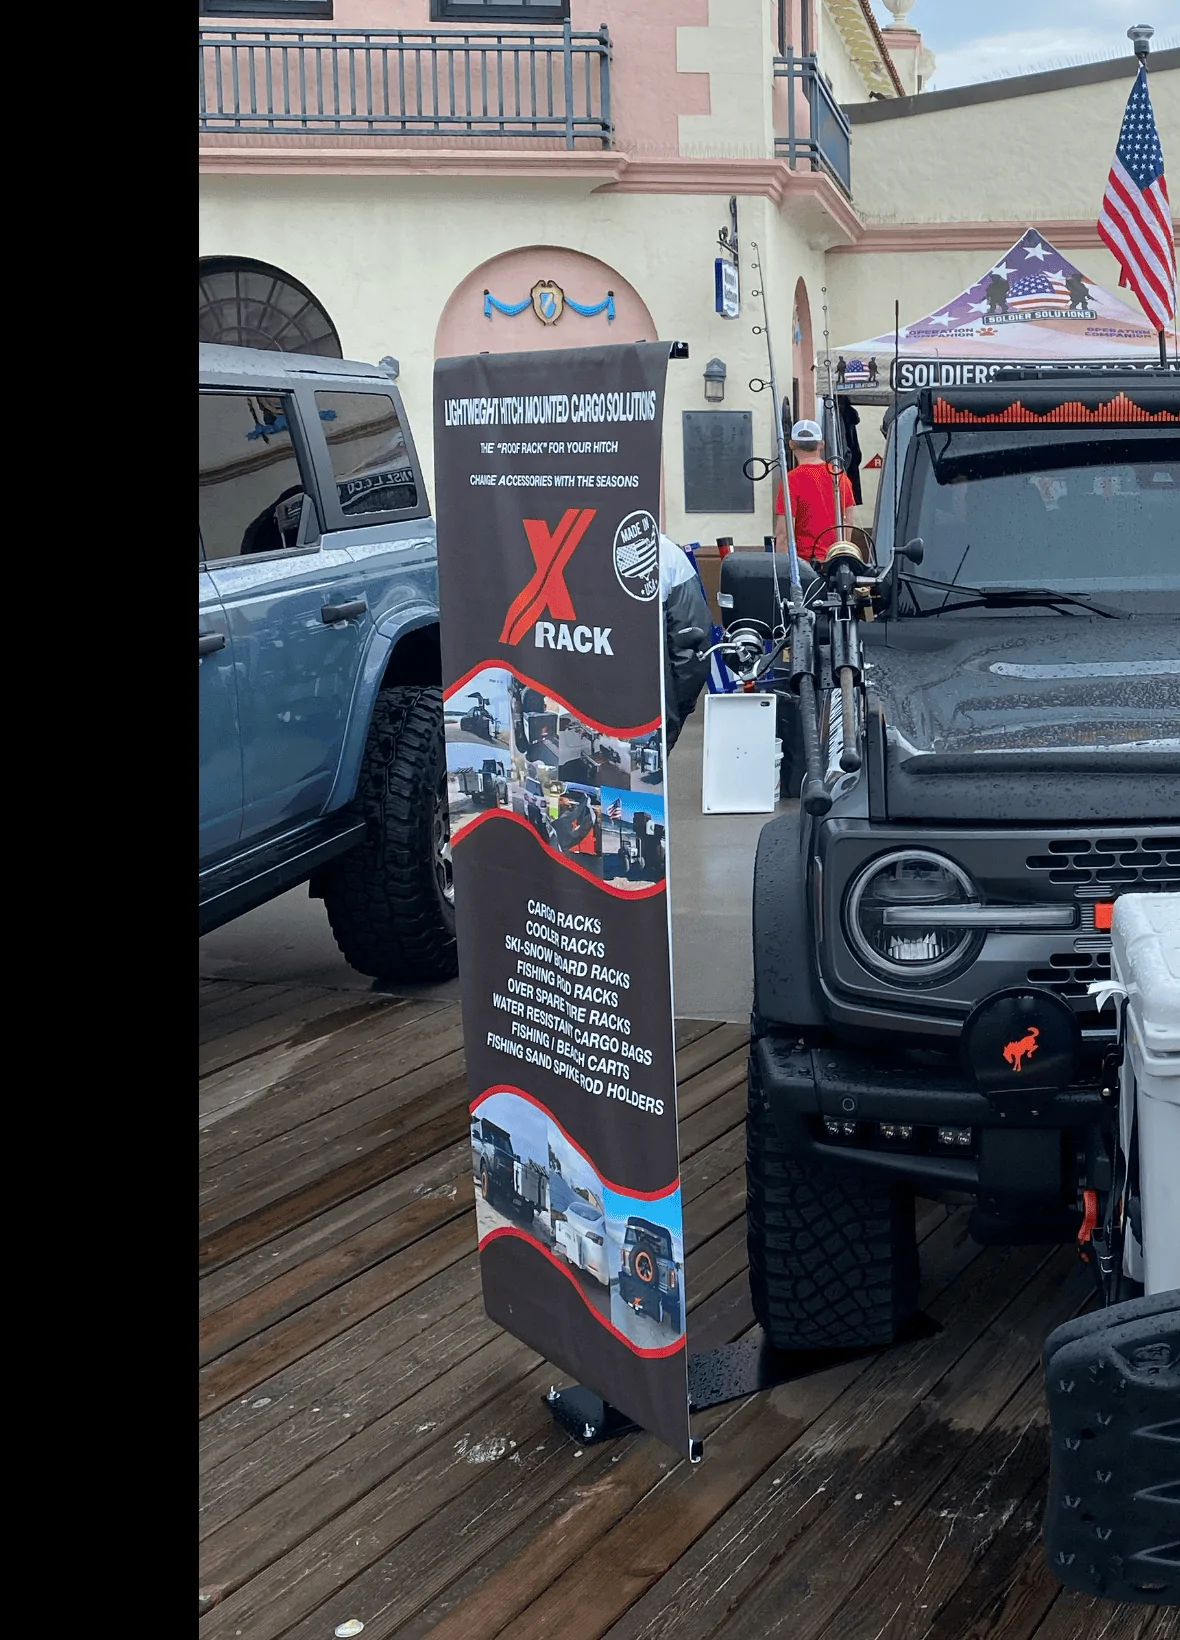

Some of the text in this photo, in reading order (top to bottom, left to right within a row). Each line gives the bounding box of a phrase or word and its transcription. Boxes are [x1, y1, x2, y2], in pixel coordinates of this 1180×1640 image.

[988, 310, 1091, 323] SOLDIER SOLUTIONS
[444, 390, 656, 426] LIGHTWEIGHT HITCH MOUNTED CARGO SOLUTIONS
[480, 442, 495, 454] THE
[548, 441, 565, 453] FOR
[567, 441, 592, 453] YOUR
[593, 441, 618, 453] HITCH
[470, 475, 639, 487] CHANGE ACCESSORIES WITH THE SEASONS
[620, 516, 650, 544] MADE IN
[644, 578, 656, 596] USA
[534, 621, 614, 656] RACK
[528, 900, 601, 934] CARGO RACKS
[526, 921, 605, 958] COOLER RACKS
[505, 935, 630, 989] SKI-SNOW BOARD RACKS
[517, 960, 618, 1008] FISHING ROD RACKS
[508, 978, 631, 1035] OVER SPARE TIRE RACKS
[493, 993, 652, 1066] WATER RESISTANT CARGO BAGS
[512, 1022, 549, 1045] FISHING
[557, 1039, 585, 1067] BEACH
[588, 1056, 630, 1080] CARTS
[487, 1032, 664, 1115] FISHING SAND SPIKE ROD HOLDERS
